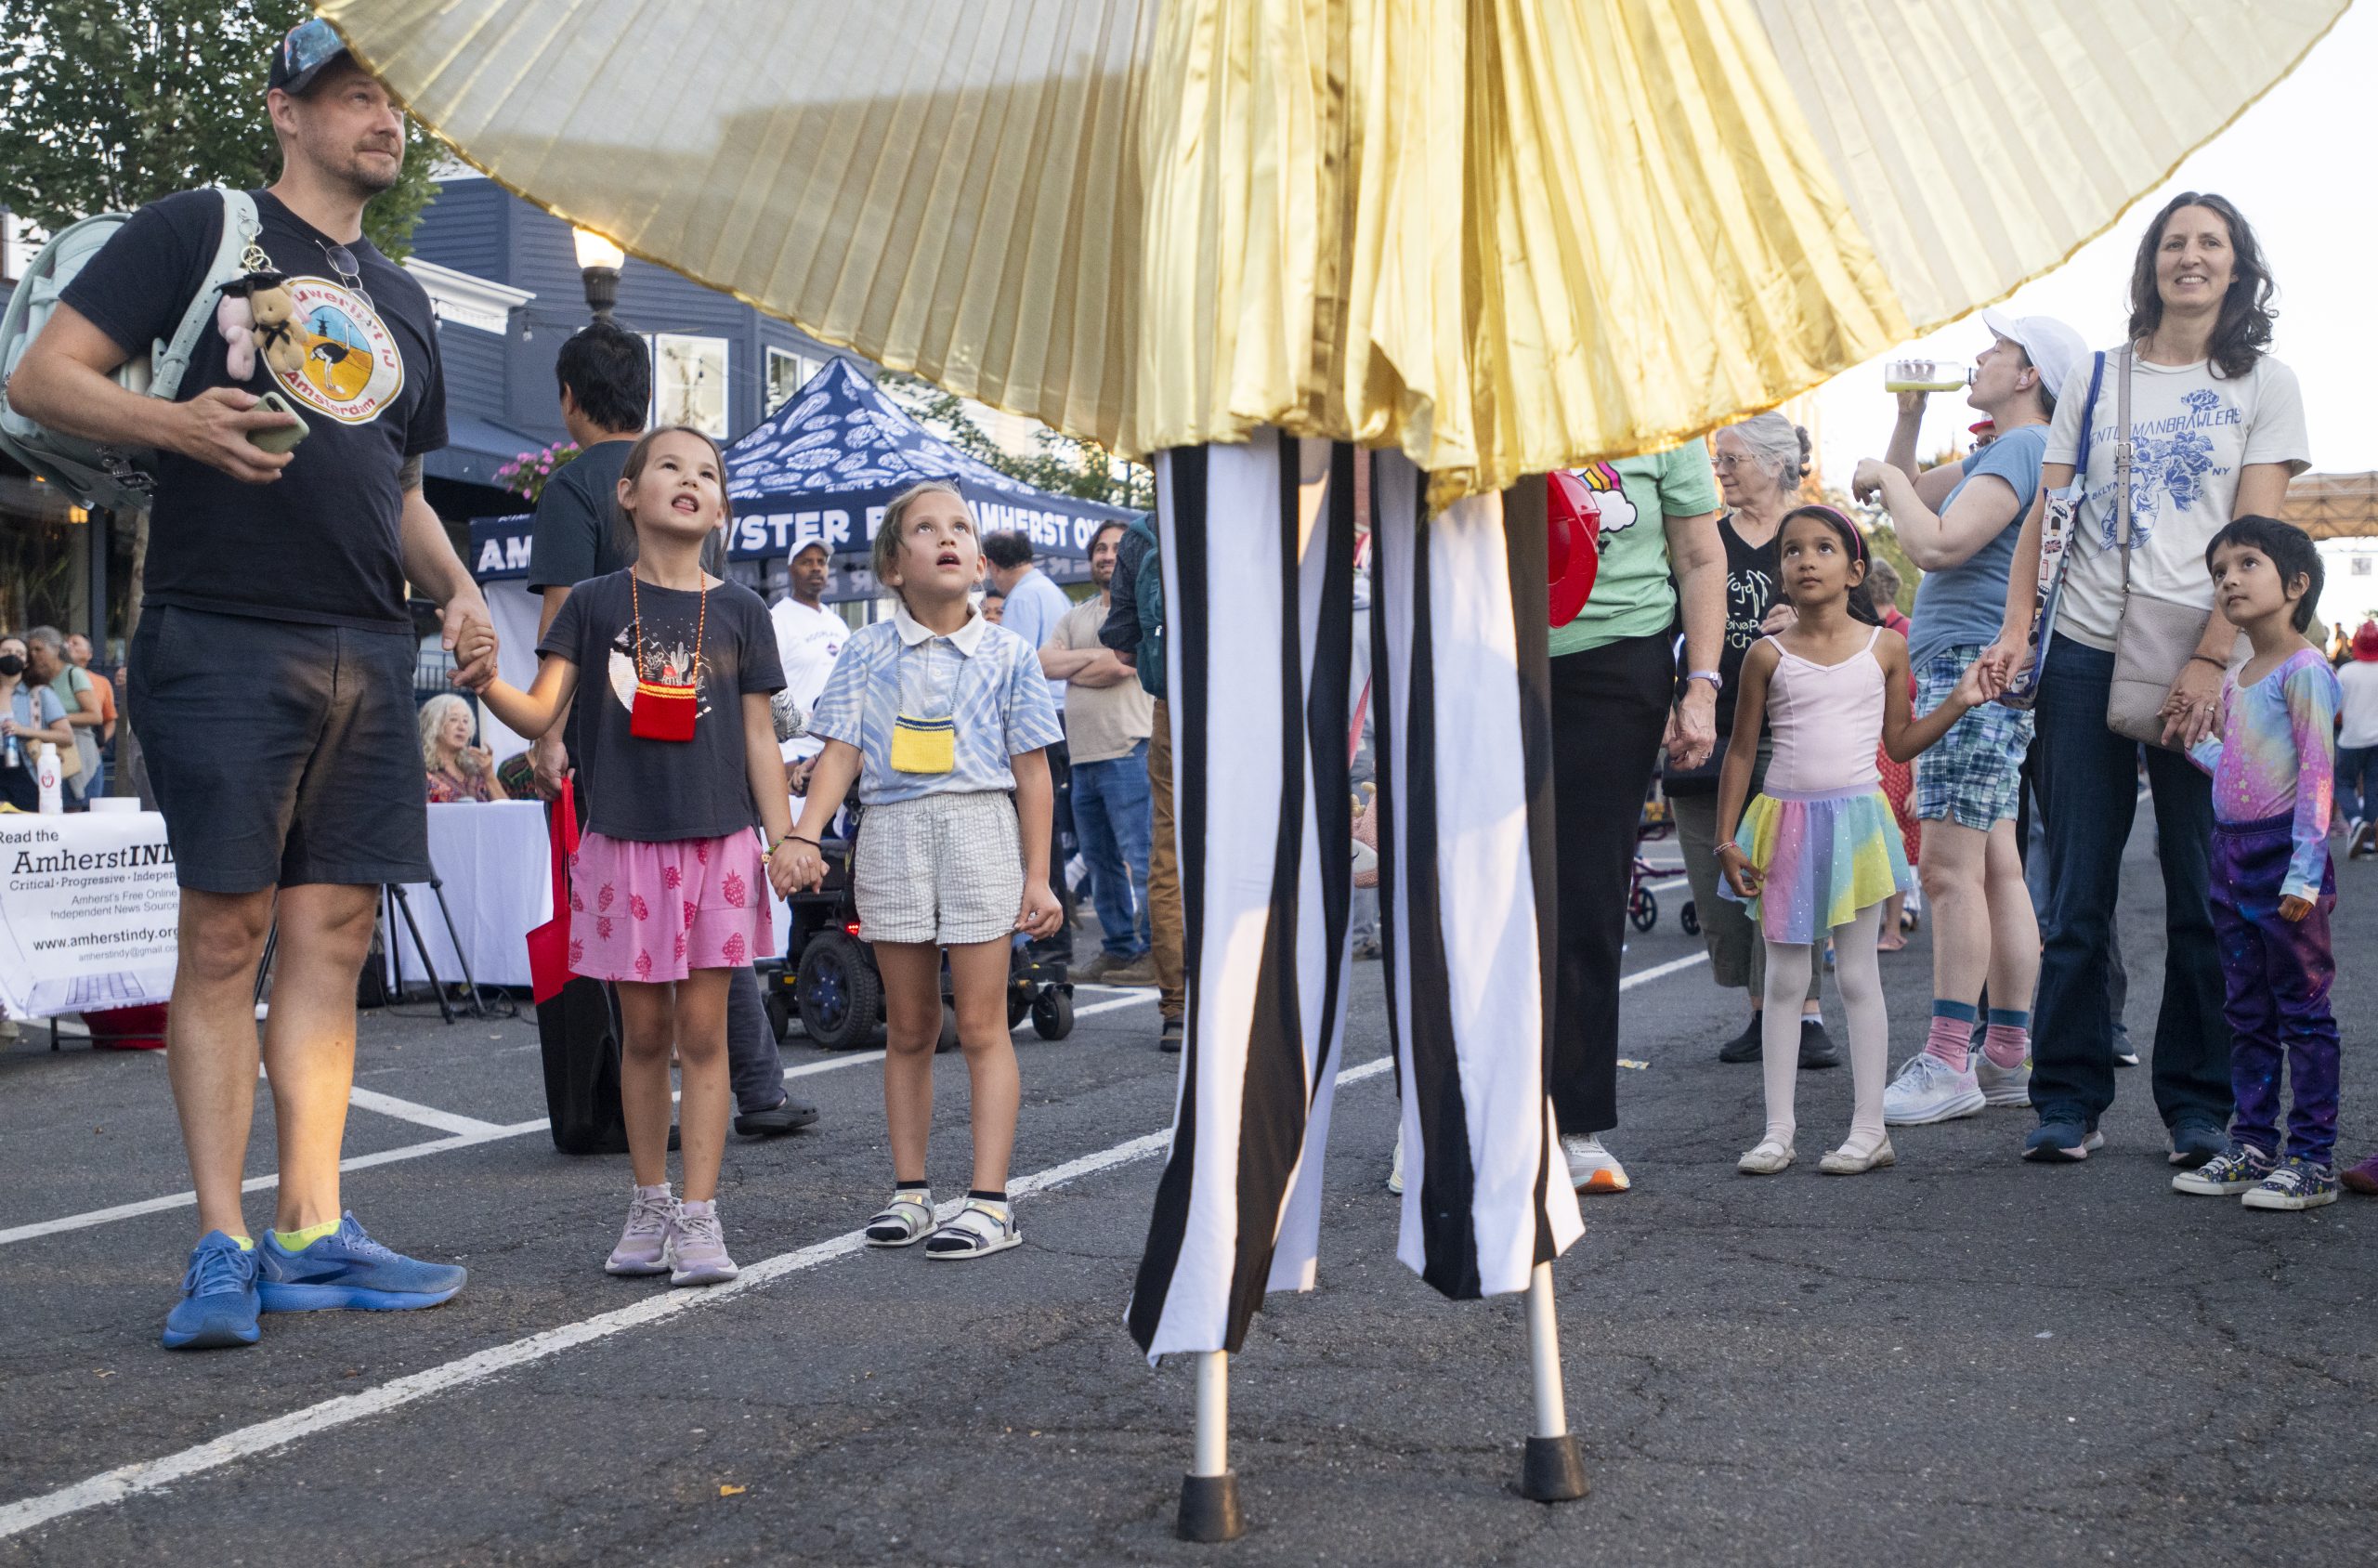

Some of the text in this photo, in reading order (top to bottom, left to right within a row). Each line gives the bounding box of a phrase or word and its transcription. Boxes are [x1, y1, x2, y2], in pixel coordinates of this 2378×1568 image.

[284, 372, 376, 415] Amsterdam
[2212, 466, 2230, 476] NY
[1749, 619, 1761, 633] P
[36, 830, 59, 842] the
[72, 889, 177, 906] Amherst's Free Online
[50, 901, 178, 921] Independent News Source
